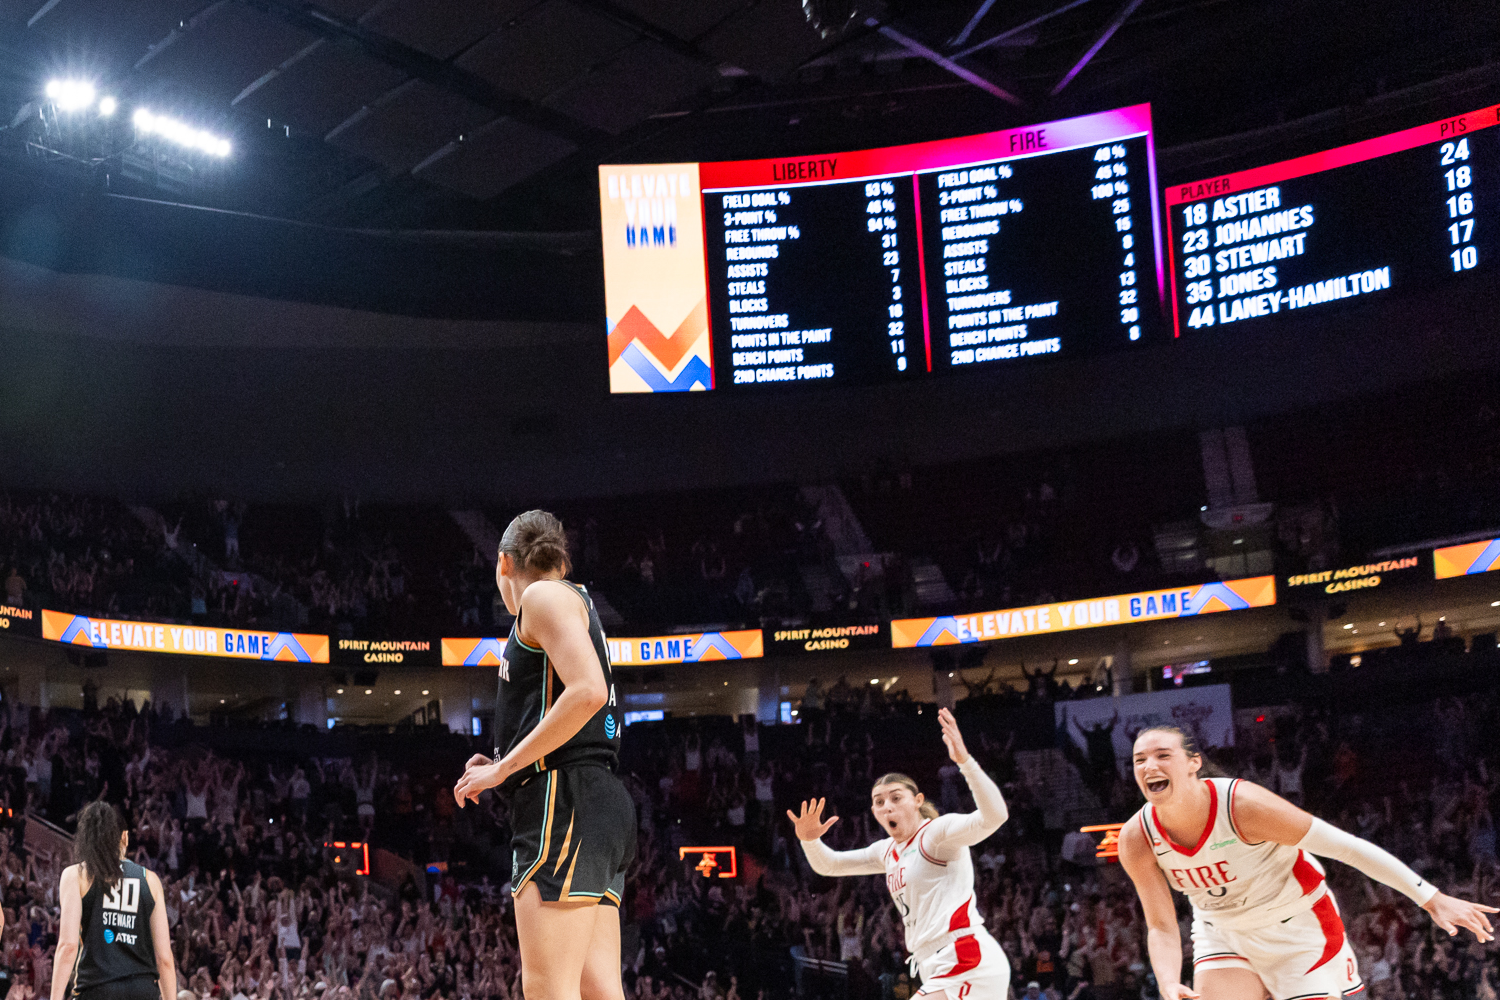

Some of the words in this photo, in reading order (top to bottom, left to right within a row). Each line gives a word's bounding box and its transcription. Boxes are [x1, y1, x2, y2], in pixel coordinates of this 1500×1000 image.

[1440, 117, 1467, 137] PTS
[1010, 129, 1047, 153] FIRE
[1440, 138, 1470, 166] 24
[773, 159, 837, 182] LIBERTY
[938, 171, 968, 188] FIELD
[969, 167, 998, 183] GOAL
[1444, 165, 1472, 191] 18
[939, 187, 983, 205] 3-POINT
[1091, 182, 1114, 199] 100
[1180, 178, 1231, 201] PLAYER
[723, 194, 750, 208] FIELD
[752, 192, 778, 207] GOAL
[1112, 197, 1131, 214] 25
[1182, 203, 1207, 227] 18
[1212, 186, 1280, 222] ASTIER
[1446, 192, 1474, 218] 16
[724, 210, 763, 226] 3-POINT
[941, 207, 969, 223] FREE
[1115, 215, 1132, 232] 15
[725, 229, 750, 243] FREE
[882, 233, 897, 248] 31
[1182, 228, 1208, 253] 23
[1447, 218, 1475, 245] 17
[943, 239, 988, 258] ASSISTS
[1184, 254, 1210, 278] 30
[1215, 232, 1308, 272] STEWART
[883, 250, 899, 266] 23
[945, 258, 986, 276] STEALS
[1124, 252, 1135, 267] 4
[1450, 245, 1478, 272] 10
[728, 263, 768, 278] ASSISTS
[891, 268, 900, 282] 7
[1119, 270, 1136, 286] 13
[728, 280, 765, 296] STEALS
[892, 285, 901, 300] 3
[1185, 279, 1213, 304] 35
[1217, 265, 1278, 299] JONES
[1187, 304, 1216, 329] 44
[1219, 265, 1391, 324] LANEY-HAMILTON
[949, 312, 987, 329] POINTS
[1002, 307, 1024, 322] THE
[888, 321, 904, 336] 32
[950, 330, 987, 347] BENCH
[988, 324, 1027, 342] POINTS
[732, 333, 767, 348] POINTS
[780, 331, 800, 345] THE
[891, 338, 904, 354] 11
[733, 351, 766, 366] BENCH
[768, 348, 803, 363] POINTS
[951, 349, 974, 364] 2ND
[975, 343, 1019, 361] CHANCE
[1020, 338, 1061, 356] POINTS
[734, 369, 755, 383] 2ND
[756, 367, 796, 382] CHANCE
[797, 364, 834, 379] POINTS
[1288, 569, 1331, 587] SPIRIT
[1333, 556, 1418, 581] MOUNTAIN
[1325, 575, 1381, 595] CASINO
[957, 597, 1051, 641] ELEVATE
[1057, 599, 1121, 629] YOUR
[1130, 591, 1191, 618] GAME
[90, 620, 164, 649] ELEVATE
[171, 627, 217, 652] YOUR
[225, 633, 269, 656] GAME
[774, 627, 810, 641] SPIRIT
[811, 625, 879, 640] MOUNTAIN
[338, 639, 370, 651] SPIRIT
[370, 640, 430, 651] MOUNTAIN
[611, 641, 633, 662] UR
[640, 638, 693, 661] GAME
[804, 638, 849, 651] CASINO
[364, 652, 403, 663] CASINO
[1170, 860, 1237, 889] FIRE
[102, 878, 141, 913] 30
[102, 911, 136, 929] STEWART
[115, 932, 138, 945] AT&T
